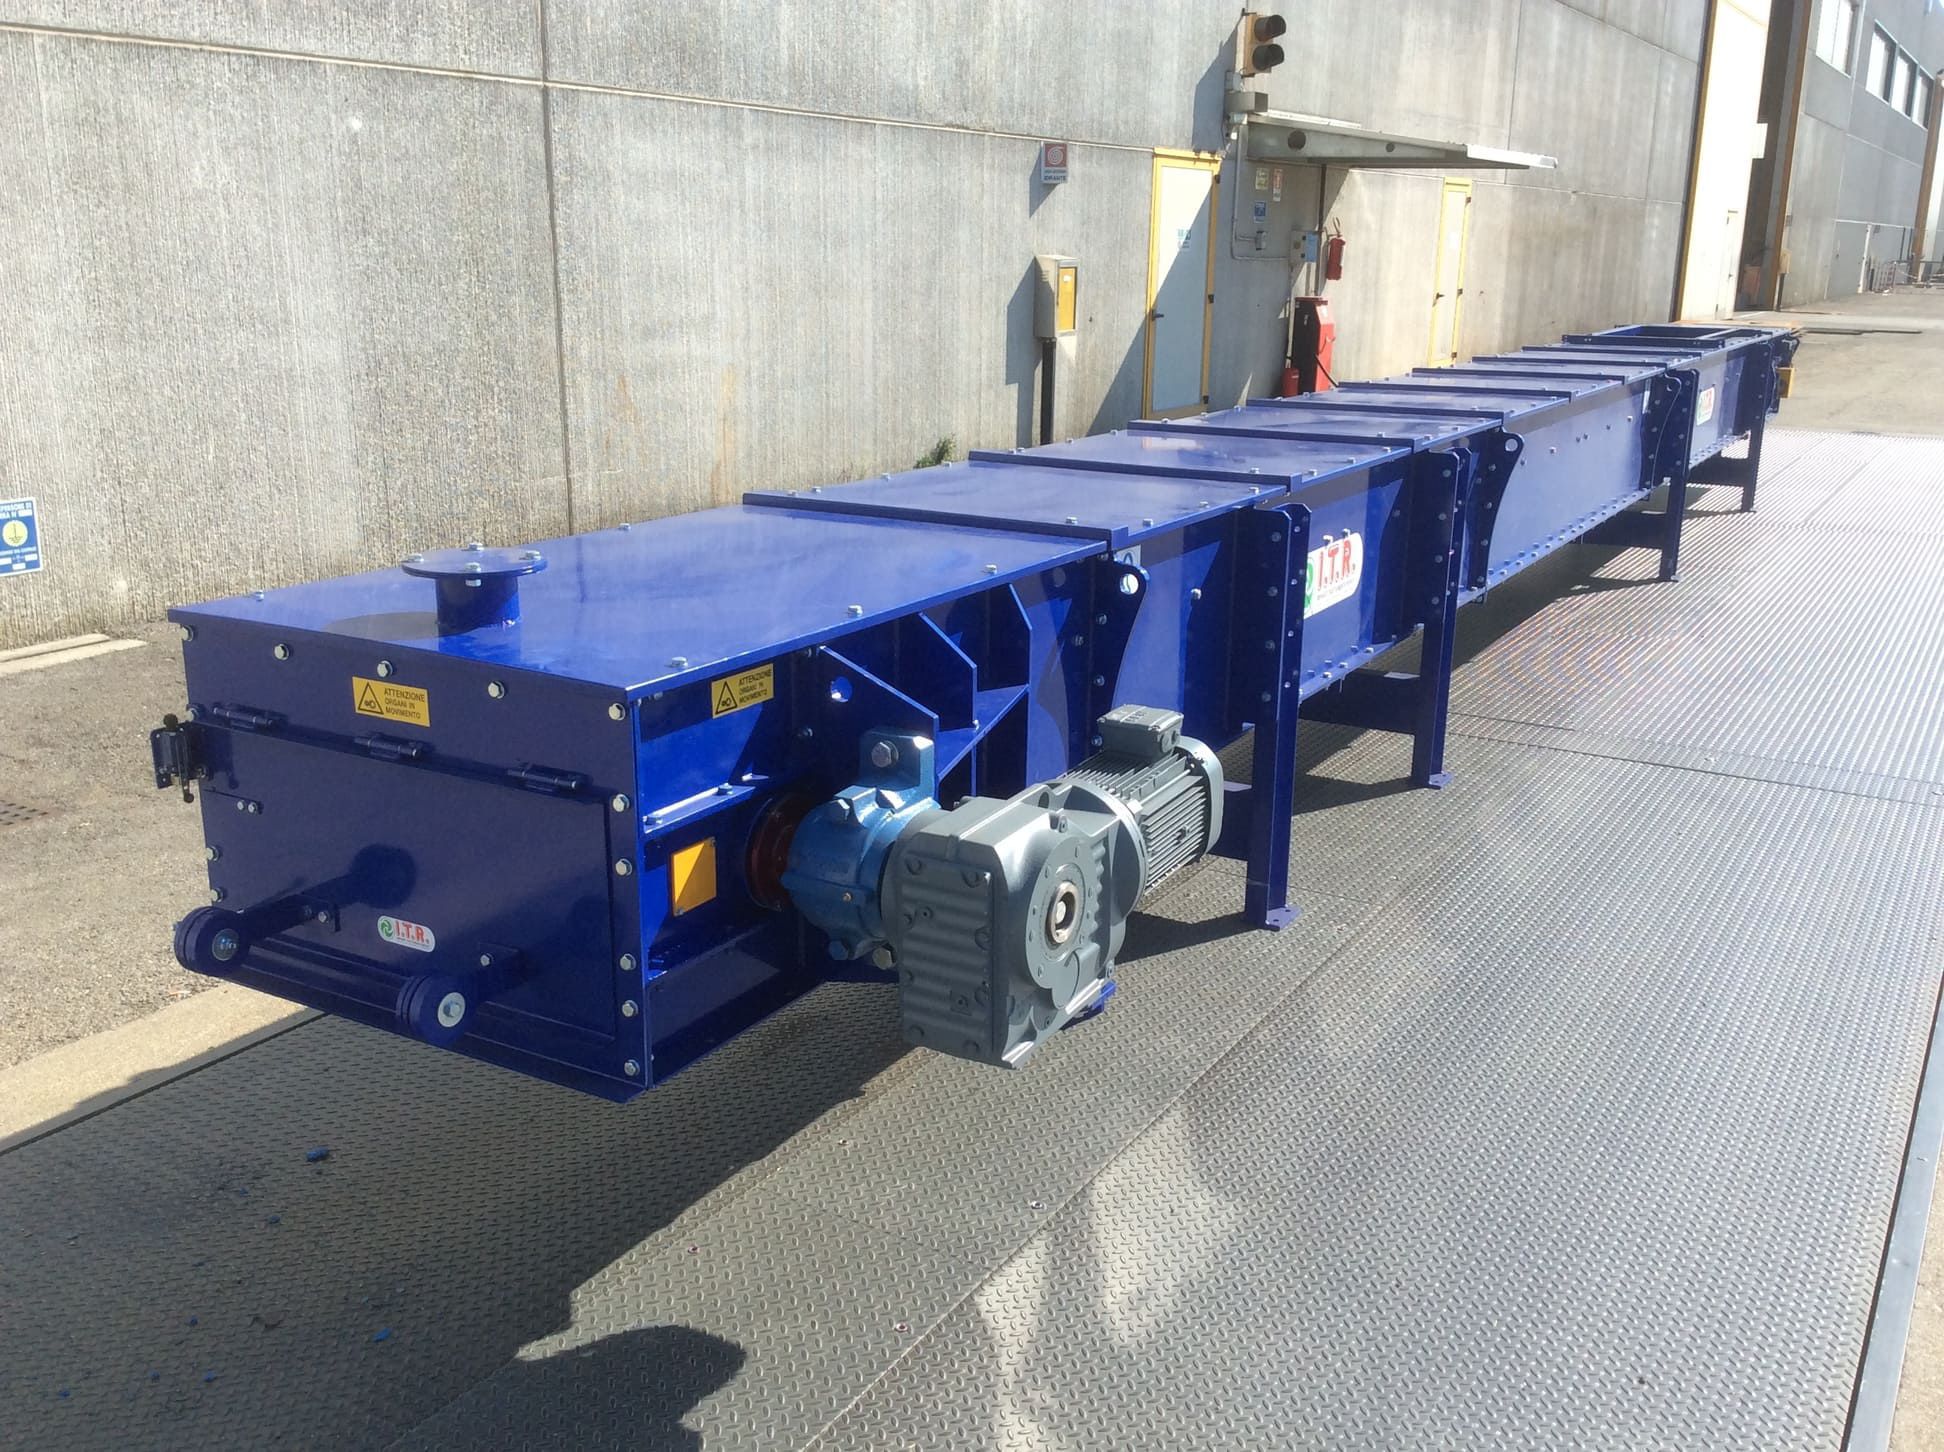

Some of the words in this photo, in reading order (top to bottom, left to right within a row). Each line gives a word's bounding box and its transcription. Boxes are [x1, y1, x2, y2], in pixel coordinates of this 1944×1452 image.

[384, 687, 425, 702] ATTENZIONE
[385, 697, 407, 708] ORGANI
[385, 706, 421, 719] MOVIMENTO
[395, 919, 430, 945] I.T.R.
